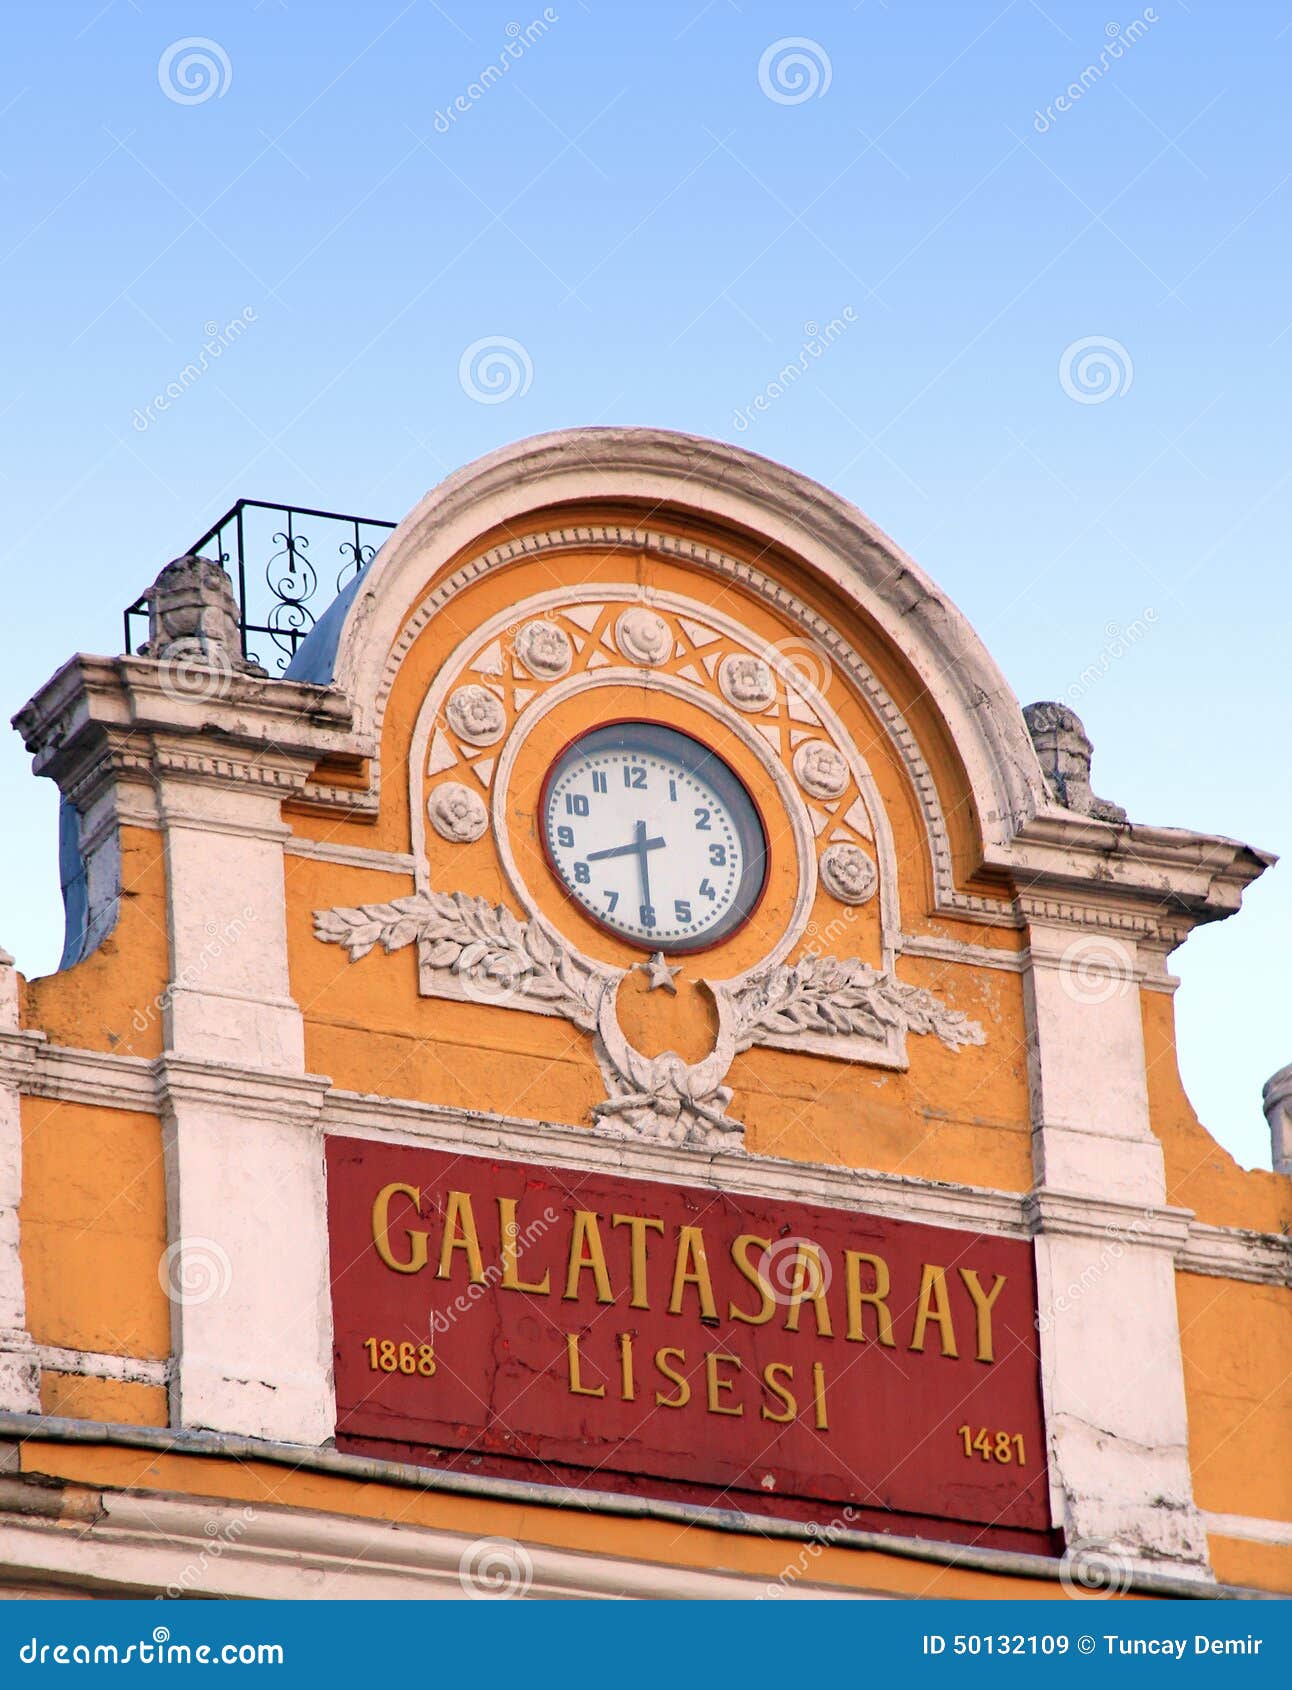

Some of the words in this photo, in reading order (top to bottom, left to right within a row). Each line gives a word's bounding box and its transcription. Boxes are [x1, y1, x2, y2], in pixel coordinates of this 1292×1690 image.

[591, 770, 608, 794] 11
[623, 765, 648, 790] 12
[565, 792, 590, 817] 10
[694, 808, 712, 830] 2
[557, 825, 575, 848] 9
[709, 844, 727, 867] 3
[573, 862, 591, 884] 8
[699, 878, 716, 900] 4
[603, 890, 619, 913] 7
[674, 899, 692, 923] 5
[639, 904, 657, 928] 6
[371, 1182, 1007, 1364] GALATASARAY
[364, 1337, 437, 1377] 1868
[958, 1425, 1026, 1465] 1481
